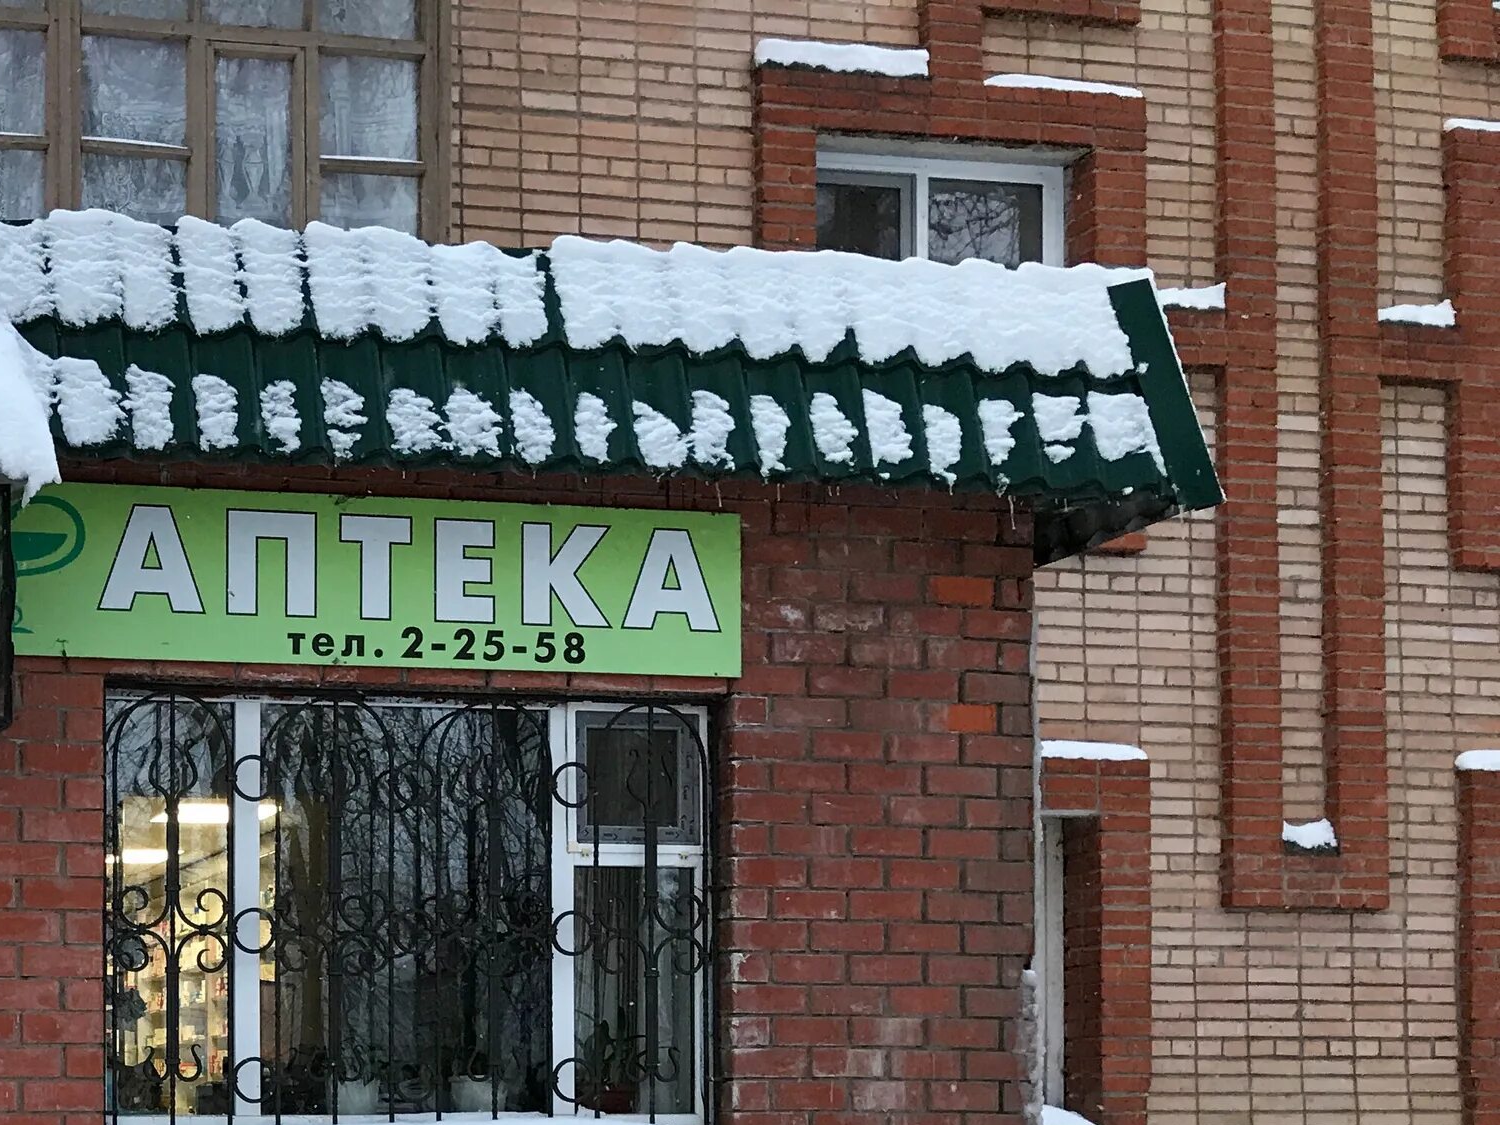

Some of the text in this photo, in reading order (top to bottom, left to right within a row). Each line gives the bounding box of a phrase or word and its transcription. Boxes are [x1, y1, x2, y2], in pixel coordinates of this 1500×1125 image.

[97, 503, 722, 633] АПТЕКА
[287, 626, 587, 664] тел. 2-25-58
